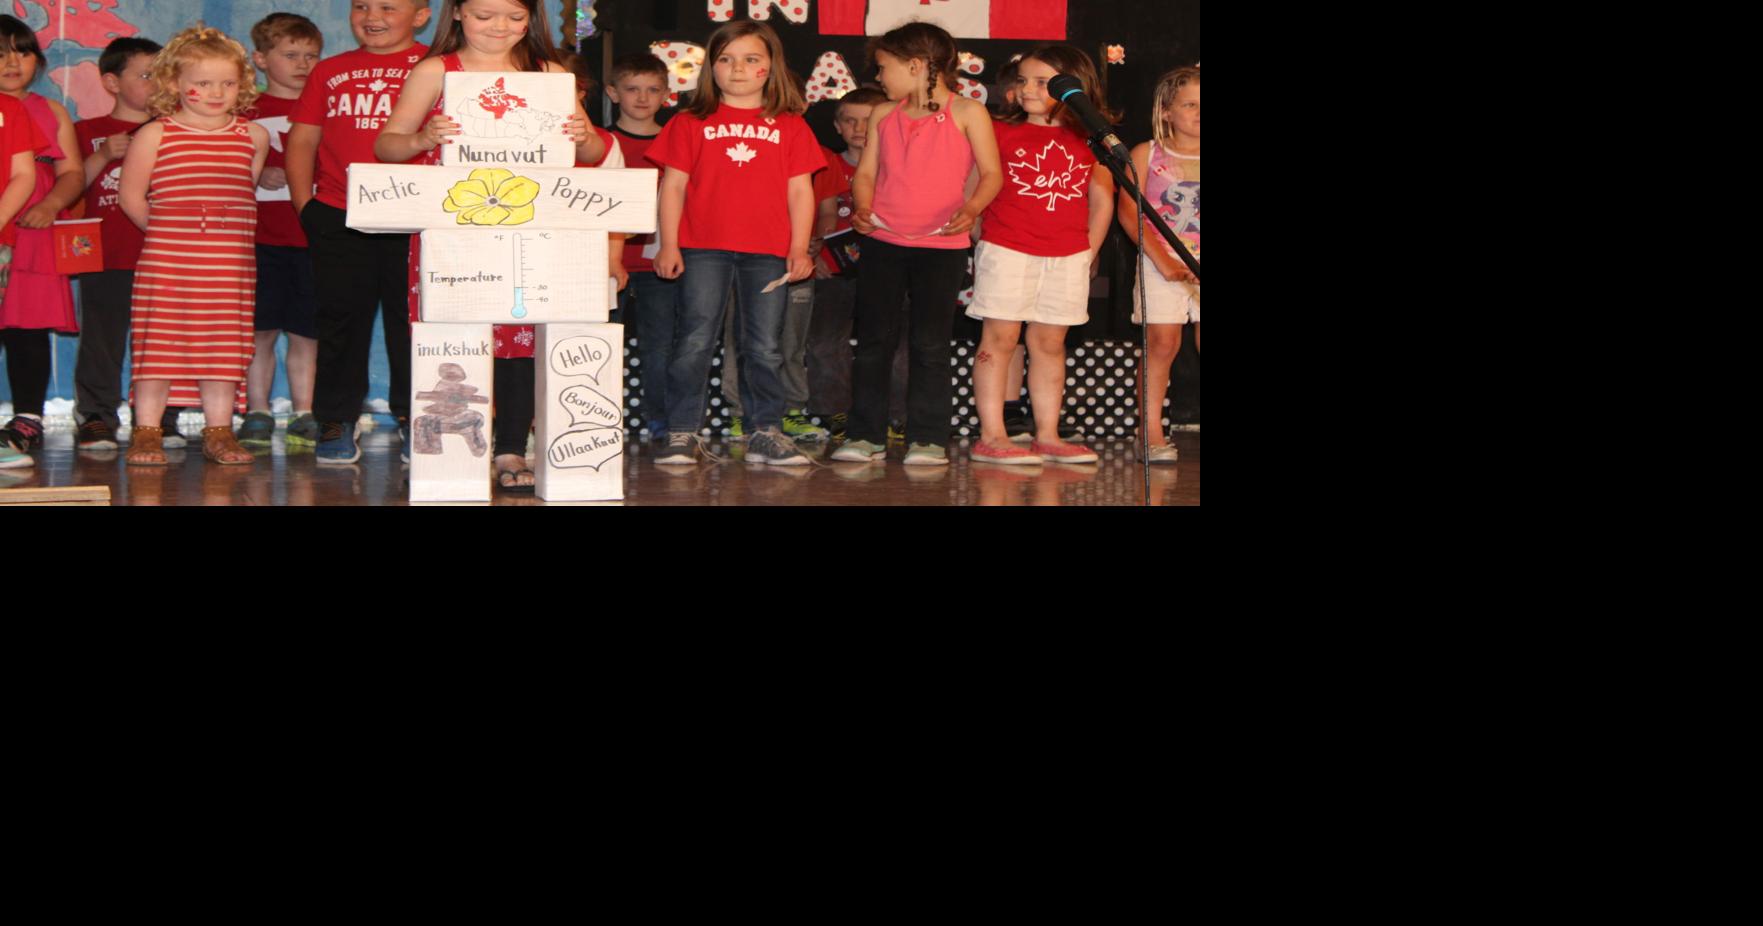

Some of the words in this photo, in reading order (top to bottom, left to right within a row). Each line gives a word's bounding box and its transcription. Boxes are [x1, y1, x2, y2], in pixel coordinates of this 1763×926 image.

[326, 72, 350, 90] FROM
[351, 69, 370, 79] SEA
[372, 68, 384, 78] TO
[385, 68, 404, 78] SEA
[326, 93, 399, 118] CANA
[703, 123, 781, 144] CANADA
[458, 144, 547, 163] Nunavut
[358, 176, 420, 204] Arctic
[1034, 171, 1072, 189] eh?
[550, 177, 622, 217] Poppy
[427, 271, 503, 287] Temperature
[559, 344, 603, 369] Hello
[564, 392, 617, 420] Bonjour
